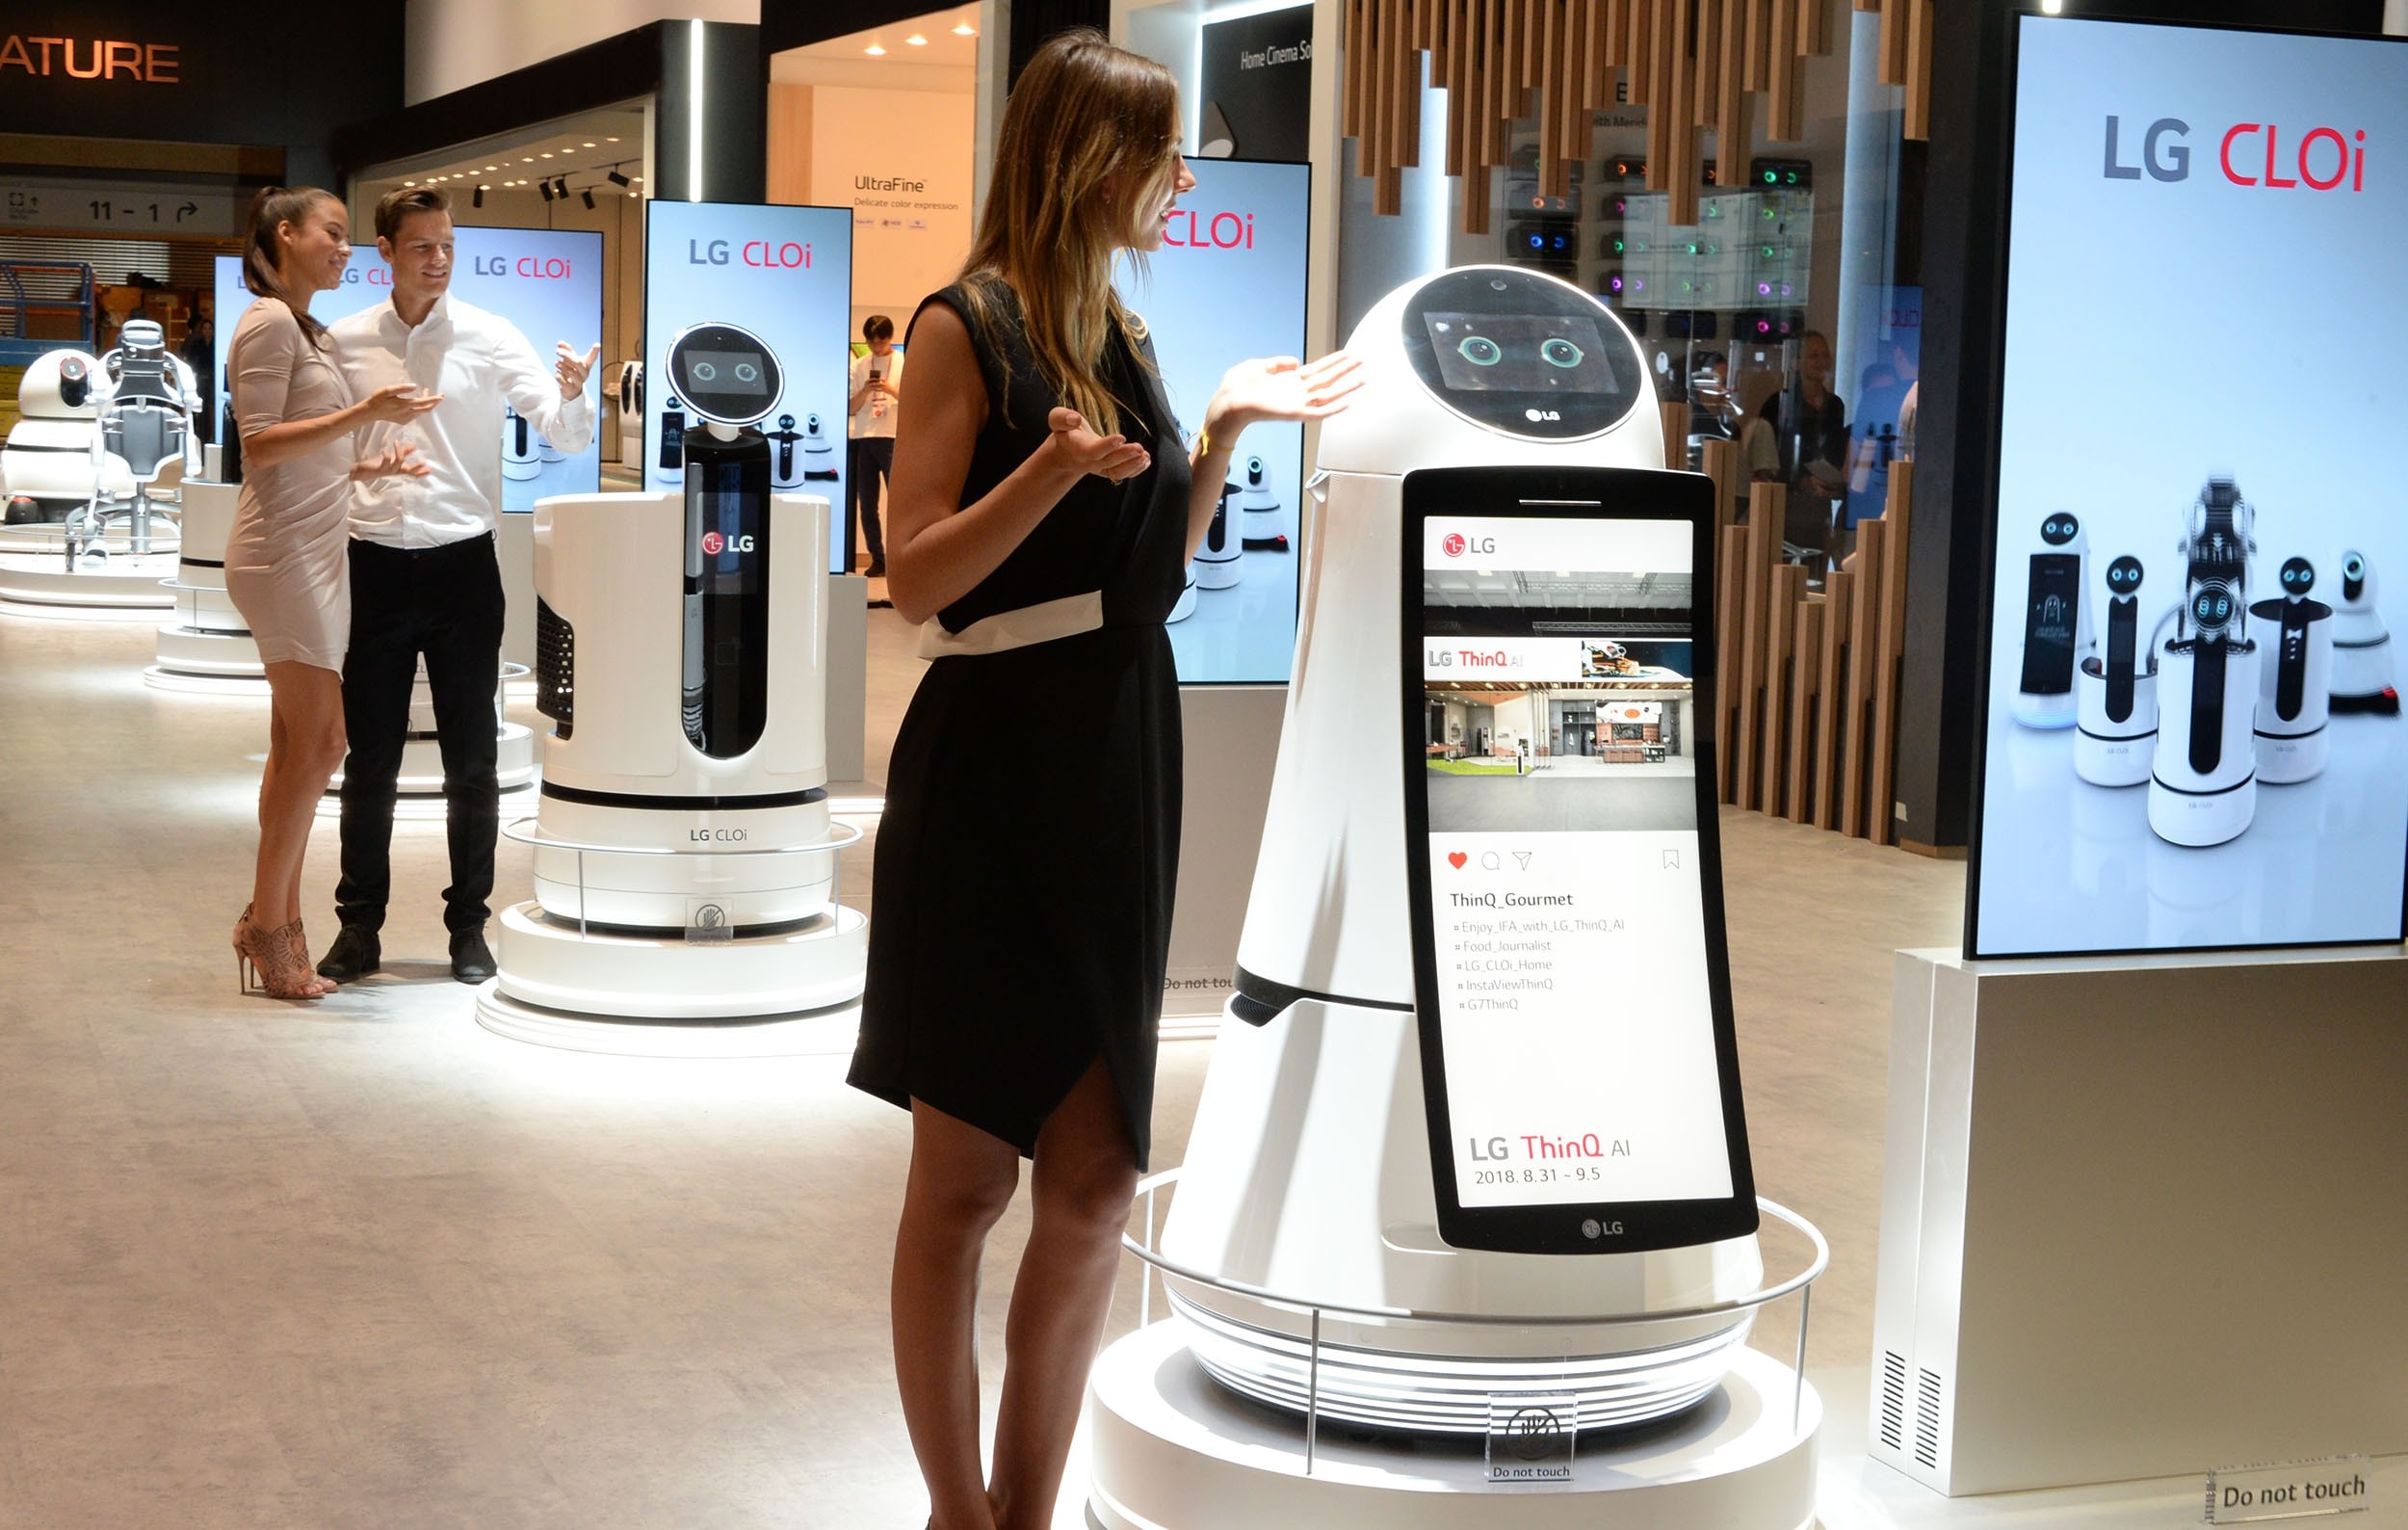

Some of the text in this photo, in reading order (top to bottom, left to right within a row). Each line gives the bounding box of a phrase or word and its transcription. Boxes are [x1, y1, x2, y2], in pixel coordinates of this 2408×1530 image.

[0, 35, 180, 84] ATURE
[1241, 40, 1312, 70] Home Cinema So
[2105, 115, 2366, 192] LG CLOi
[854, 175, 925, 193] UltraFine
[90, 200, 112, 221] 11
[148, 203, 158, 223] 1
[854, 198, 958, 210] Delicate color expression
[1162, 210, 1254, 250] CLOi
[690, 239, 811, 269] LG CLOi
[475, 255, 571, 279] LG CLOi
[339, 268, 395, 285] G CL
[728, 535, 754, 553] LG
[1470, 538, 1496, 554] LG
[1428, 650, 1453, 667] LG
[1458, 650, 1507, 667] ThinQ
[691, 829, 747, 841] LG CLOi
[1450, 892, 1574, 909] ThinQ_Gourmet
[1186, 977, 1208, 989] not
[1470, 1133, 1631, 1162] LG ThinQ AI
[1576, 1167, 1601, 1181] 9.5
[1603, 1221, 1624, 1235] LG
[1493, 1465, 1570, 1478] Do not touch
[2223, 1474, 2365, 1508] Do not touch
